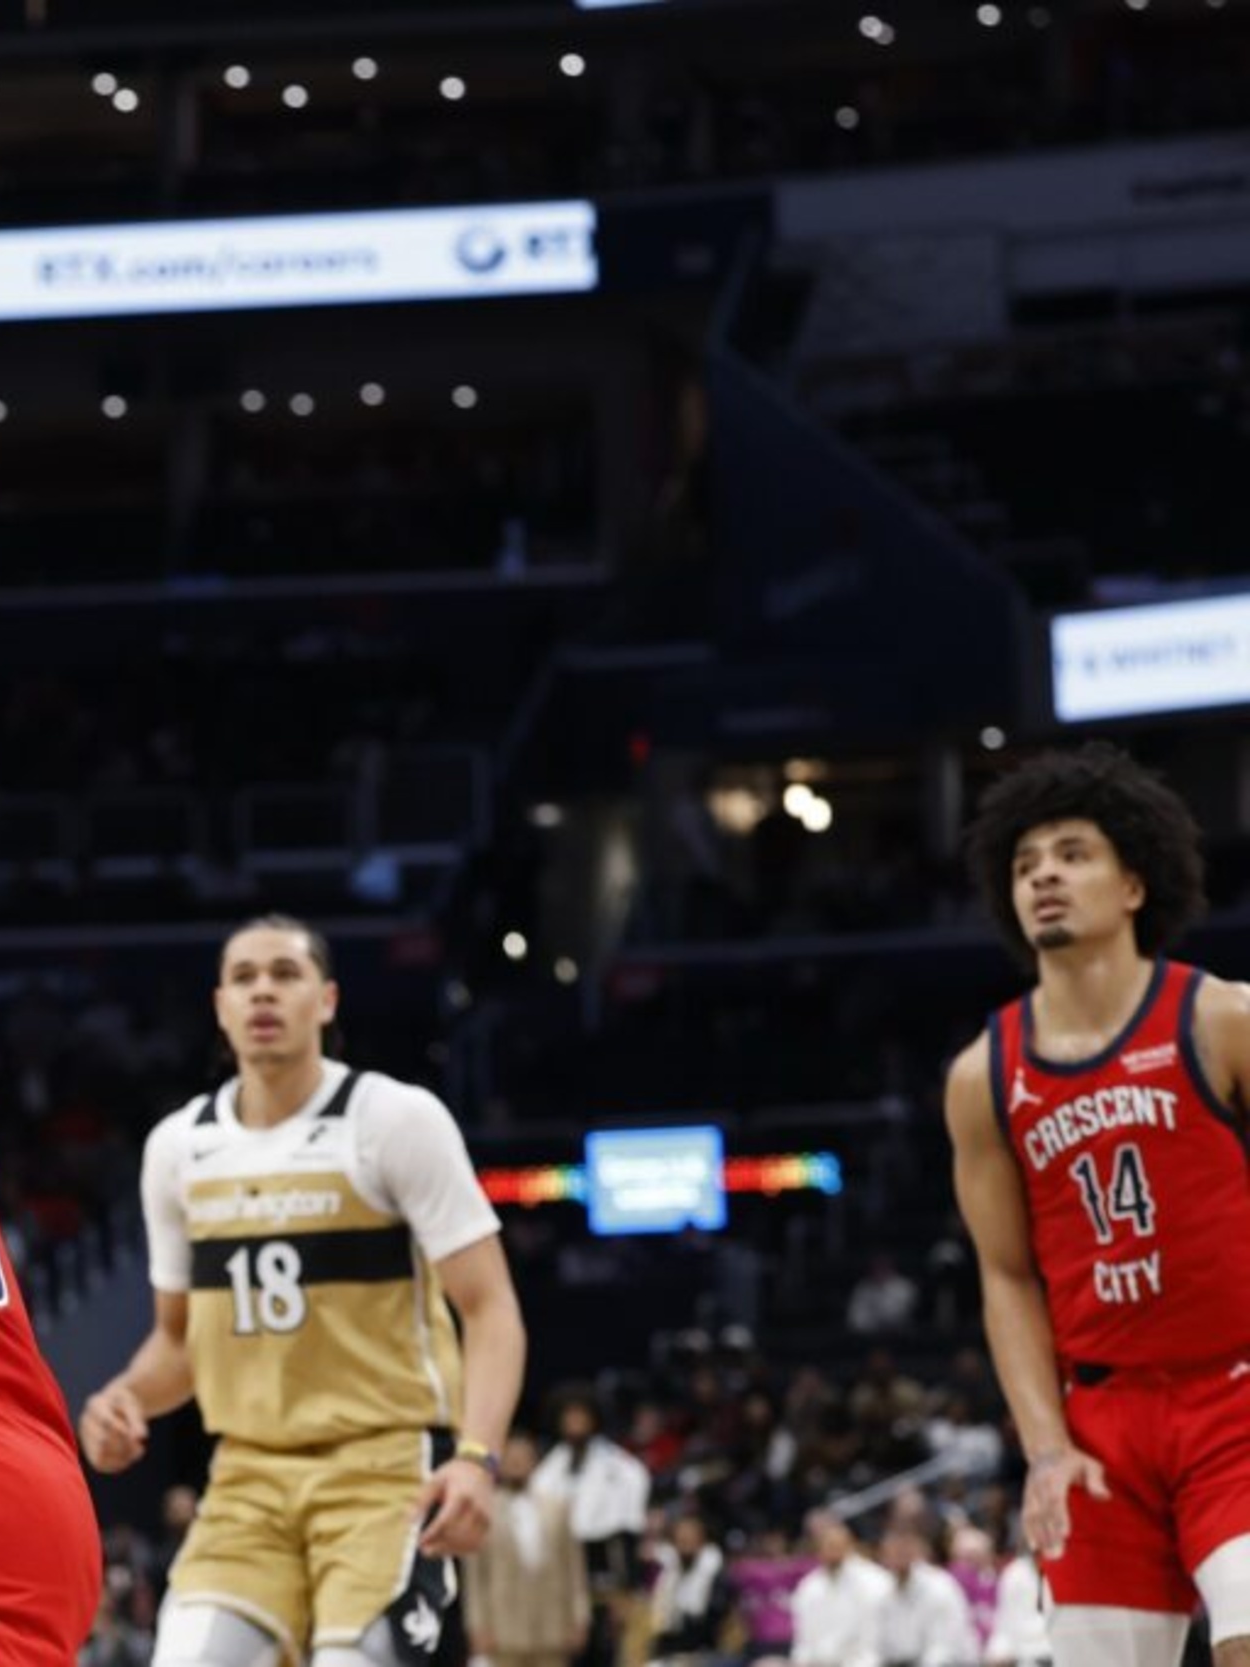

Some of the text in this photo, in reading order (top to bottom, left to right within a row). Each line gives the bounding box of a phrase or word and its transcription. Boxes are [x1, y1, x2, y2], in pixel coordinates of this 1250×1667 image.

[1024, 1086, 1178, 1171] CRESCENT
[1069, 1143, 1155, 1245] 14
[225, 1241, 309, 1336] 18
[1093, 1251, 1160, 1304] CITY
